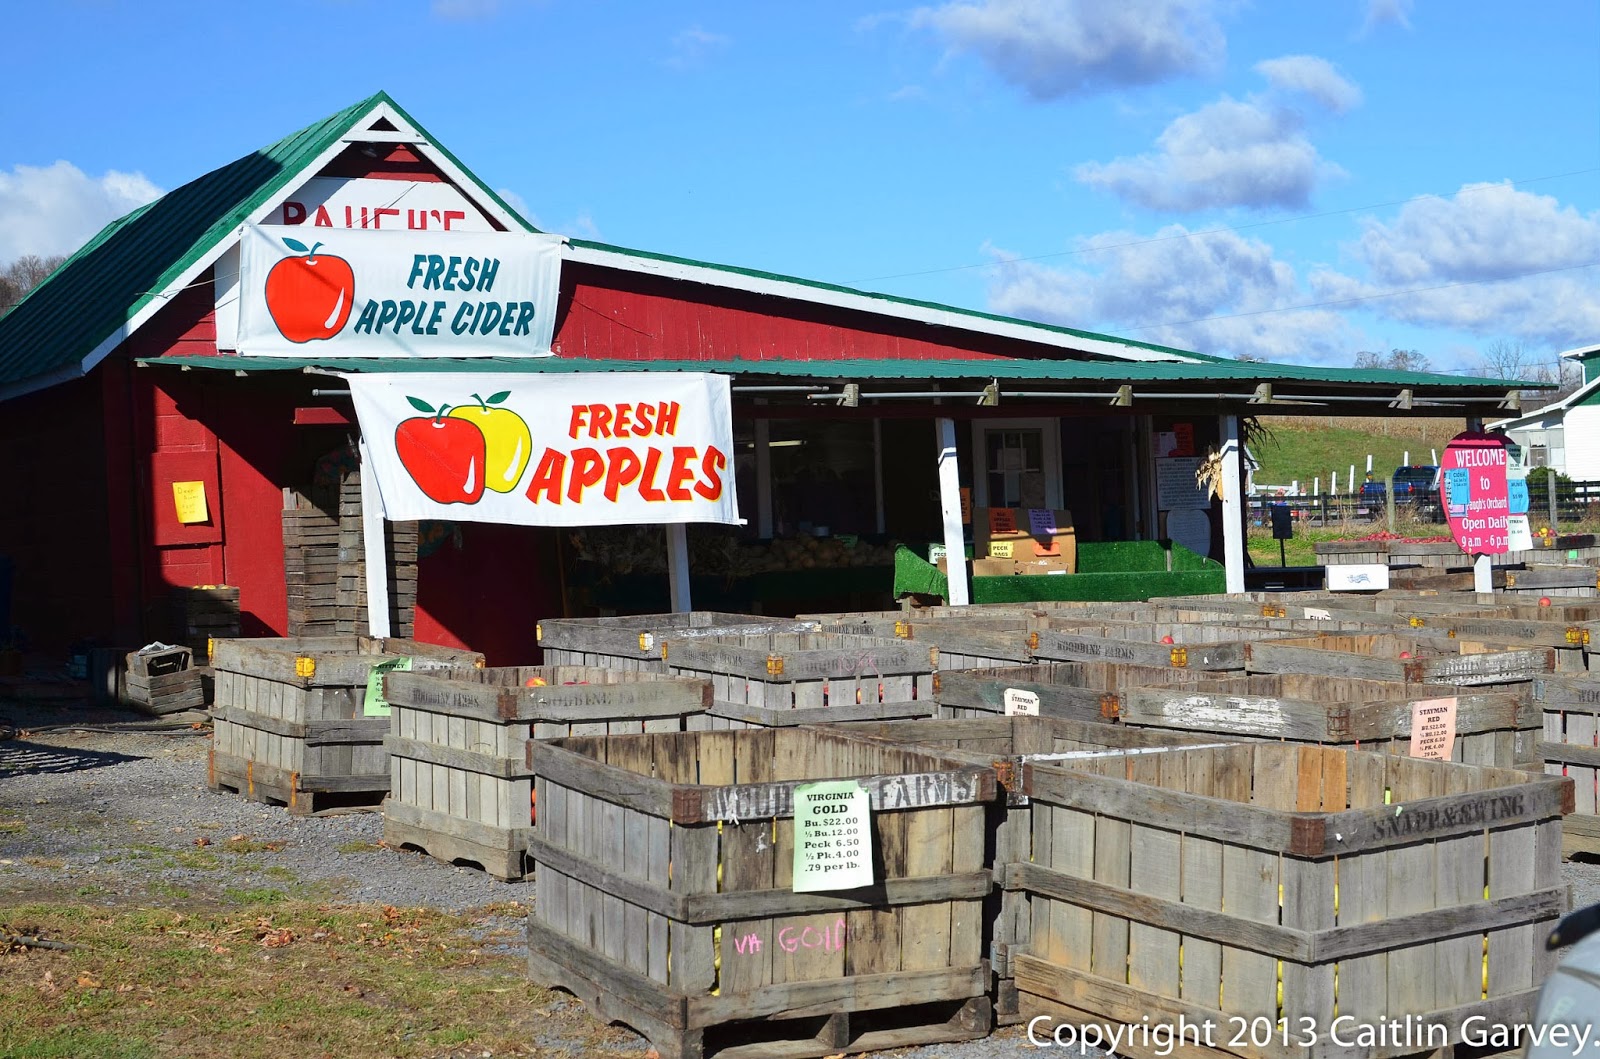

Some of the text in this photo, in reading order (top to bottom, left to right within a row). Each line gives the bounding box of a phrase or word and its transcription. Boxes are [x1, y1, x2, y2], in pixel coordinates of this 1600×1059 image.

[407, 253, 501, 293] FRESH
[354, 299, 535, 337] APPLE CIDER
[568, 400, 681, 440] FRESH
[1454, 448, 1506, 468] WELCOME
[524, 444, 726, 506] APPLES
[1480, 475, 1491, 490] to
[1467, 496, 1507, 512] augh's Orchard
[1461, 515, 1509, 532] Open Daily
[1461, 535, 1467, 548] 9
[1489, 534, 1495, 547] 6
[1104, 645, 1135, 660] FARMS
[1419, 706, 1448, 716] STAYMAN
[807, 791, 855, 802] VIRGINIA
[877, 773, 977, 810] FARMS
[812, 804, 849, 815] GOLD
[804, 838, 860, 849] Peck 6.50
[804, 861, 861, 873] .79 per lb.
